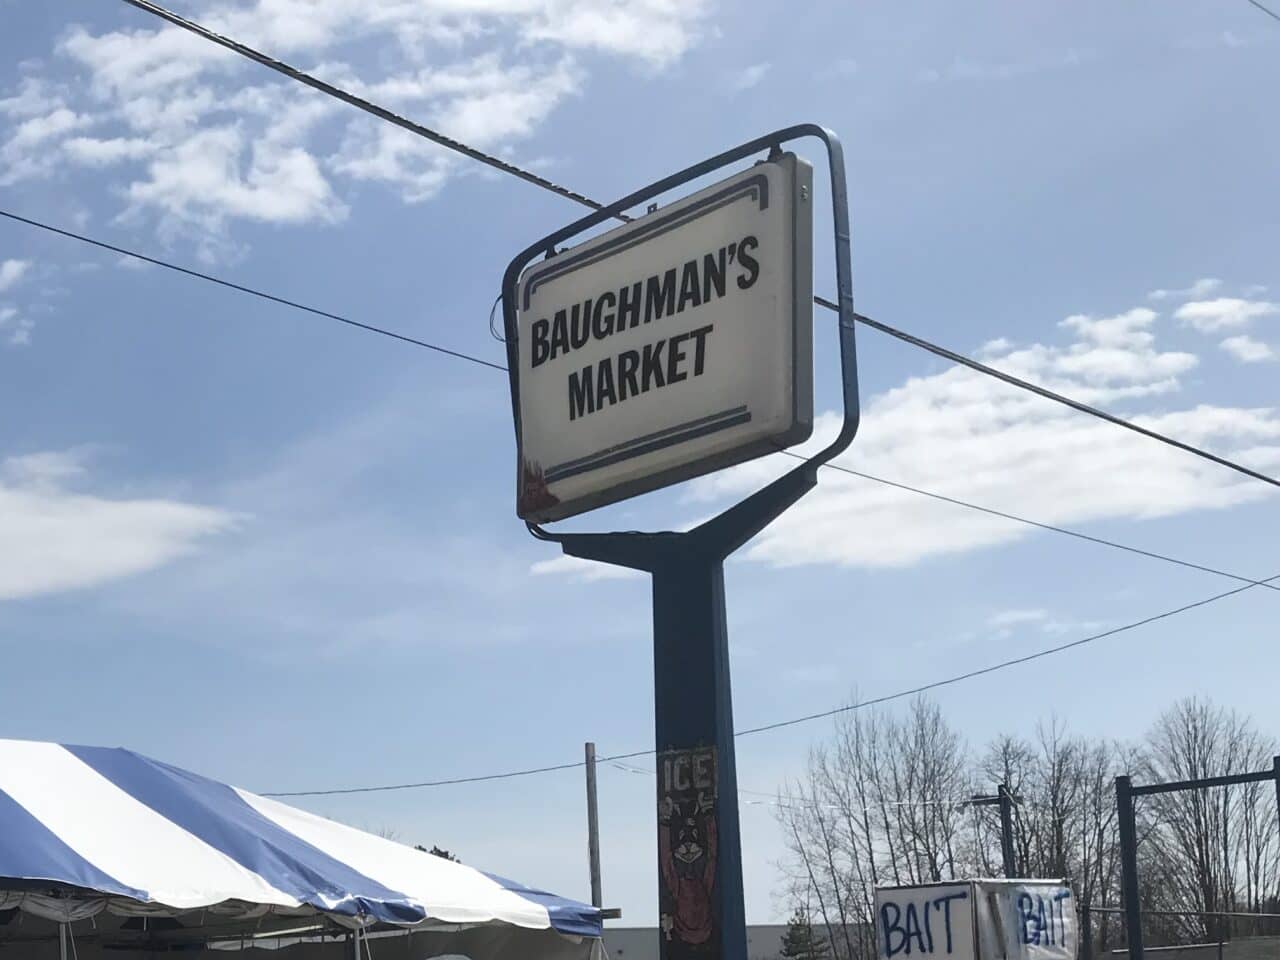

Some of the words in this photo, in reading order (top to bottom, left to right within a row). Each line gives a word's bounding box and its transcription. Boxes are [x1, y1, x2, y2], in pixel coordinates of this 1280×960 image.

[531, 236, 759, 368] BAUGHMAN'S
[568, 325, 714, 421] MARKET
[663, 754, 713, 791] ICE
[880, 891, 967, 958] BAIT
[1018, 888, 1070, 947] BAIT
